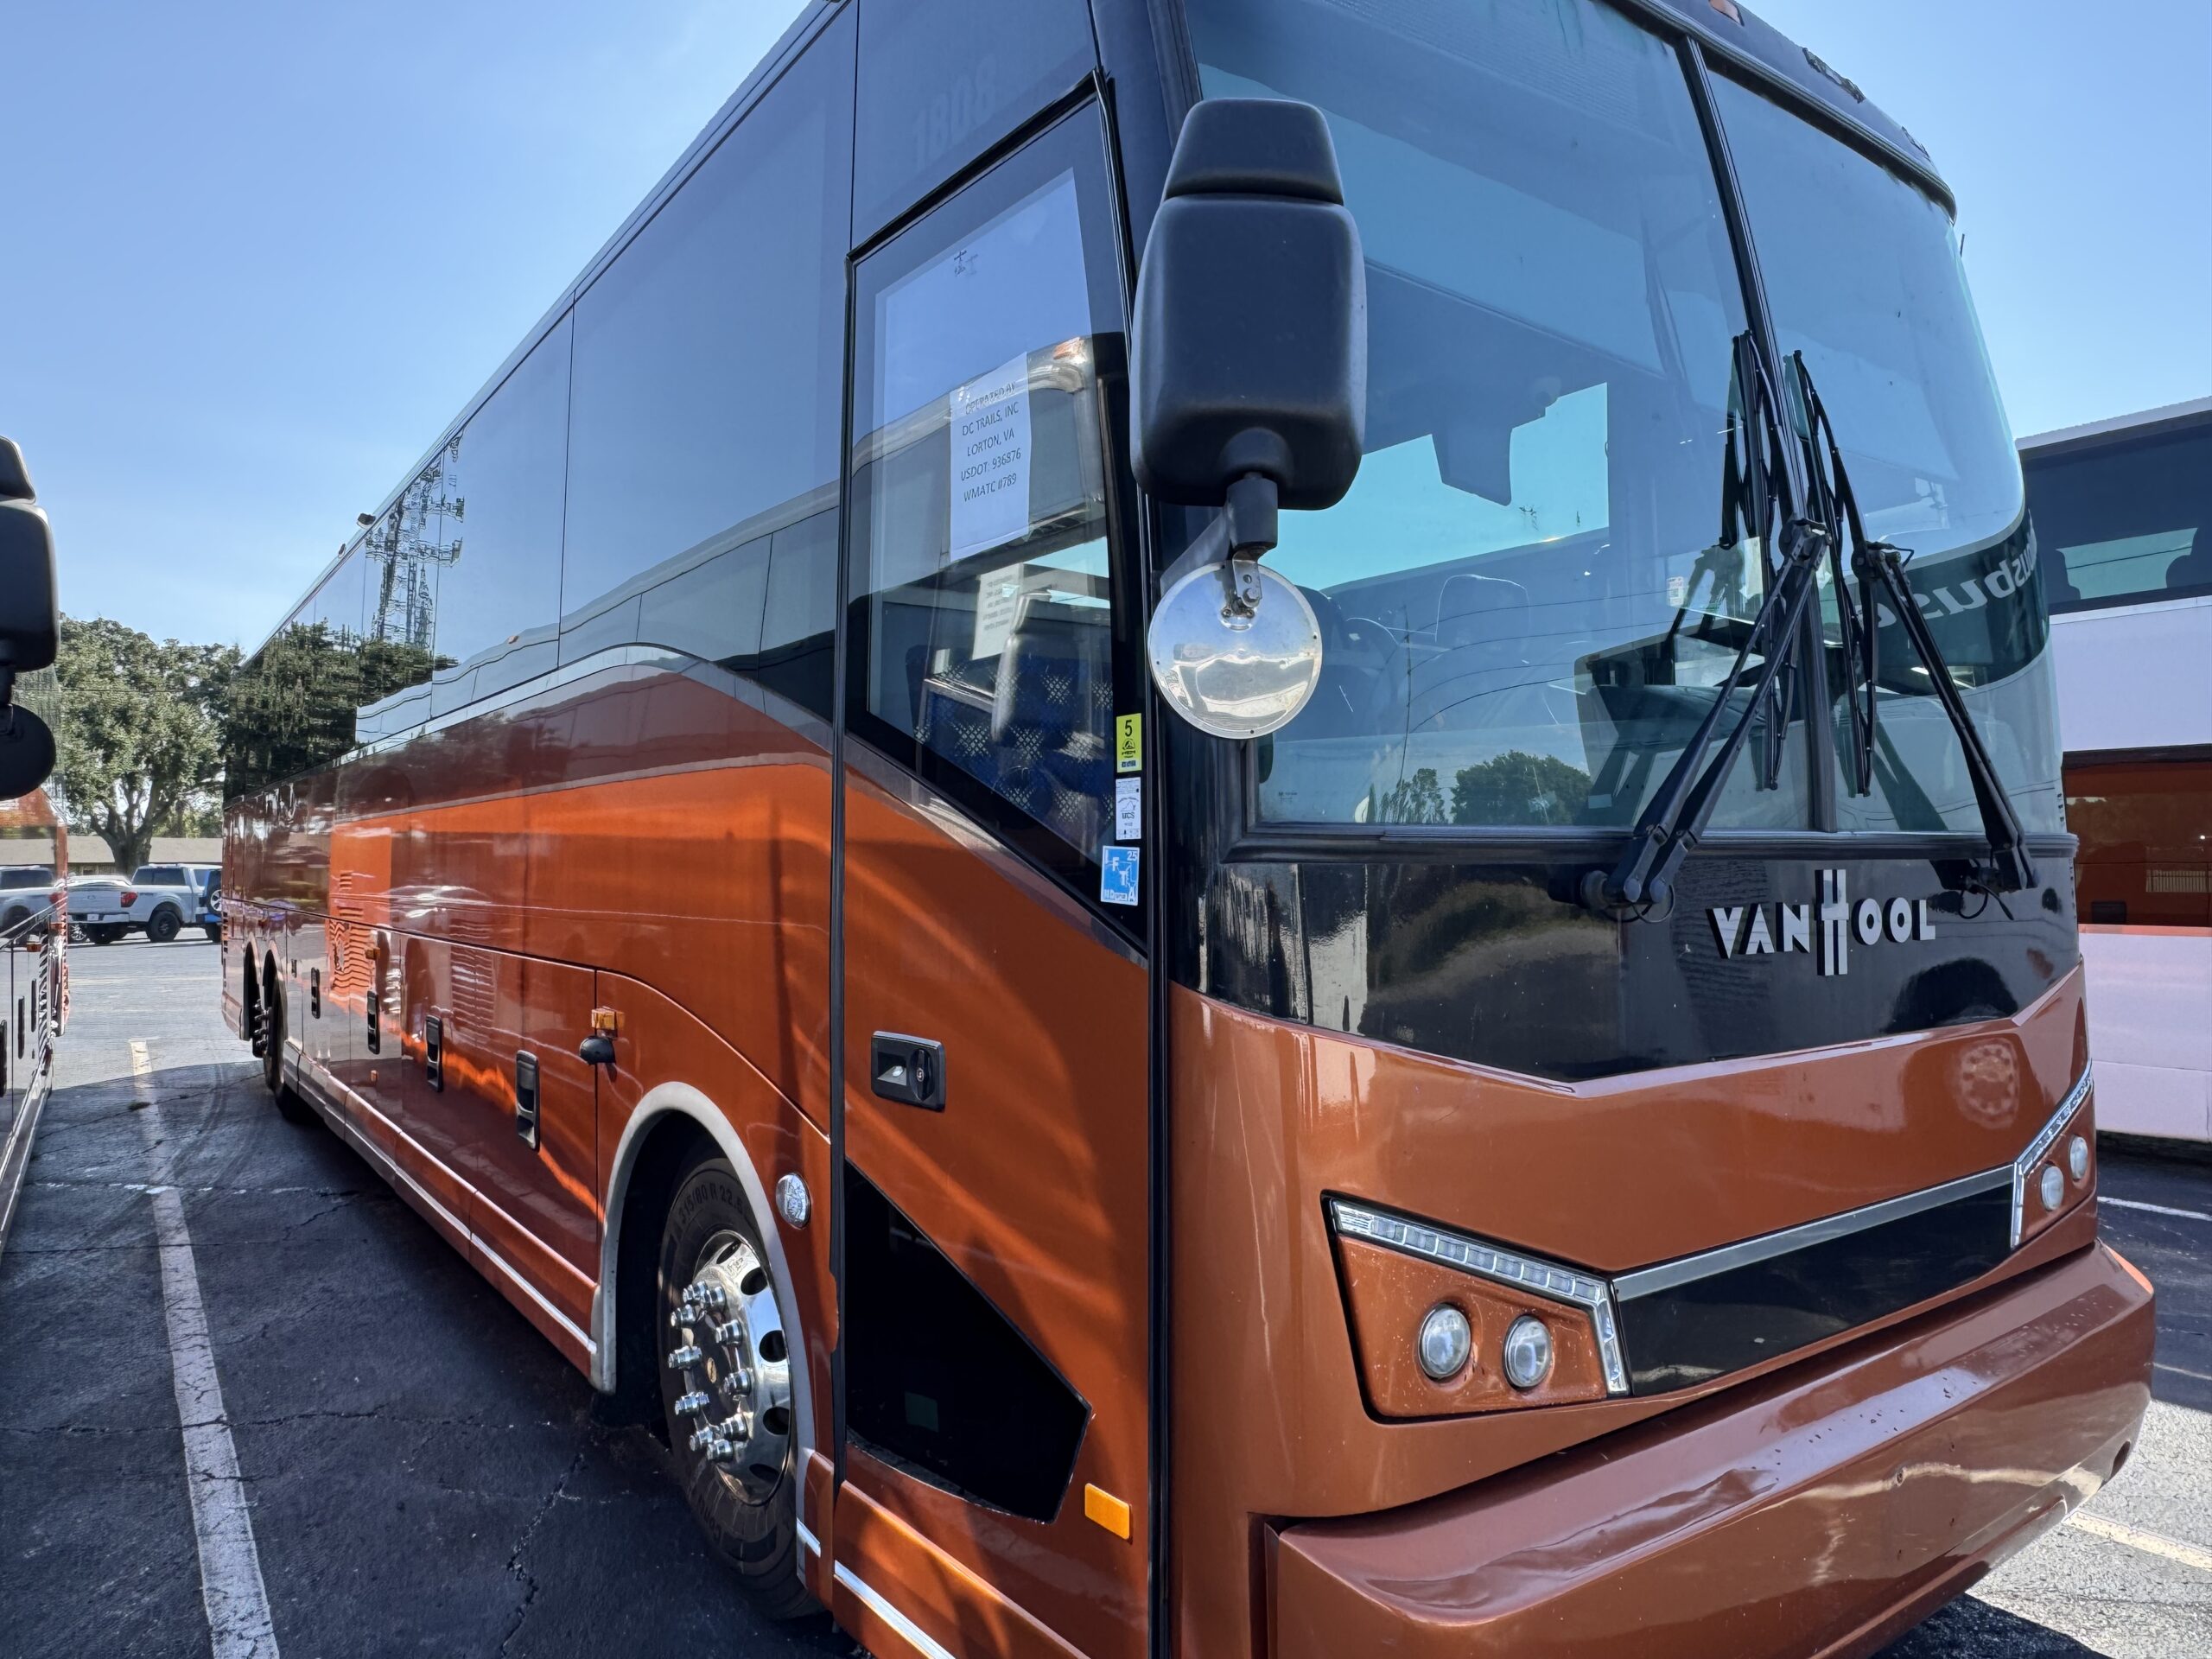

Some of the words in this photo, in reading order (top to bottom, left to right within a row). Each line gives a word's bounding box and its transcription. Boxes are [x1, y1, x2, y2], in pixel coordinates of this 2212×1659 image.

[962, 422, 974, 435] DC
[1005, 401, 1020, 418] INC
[1003, 428, 1014, 442] VA
[992, 448, 1021, 470] 936876
[963, 480, 995, 502] WMATC
[1125, 719, 1133, 737] 5
[1126, 850, 1137, 861] 25
